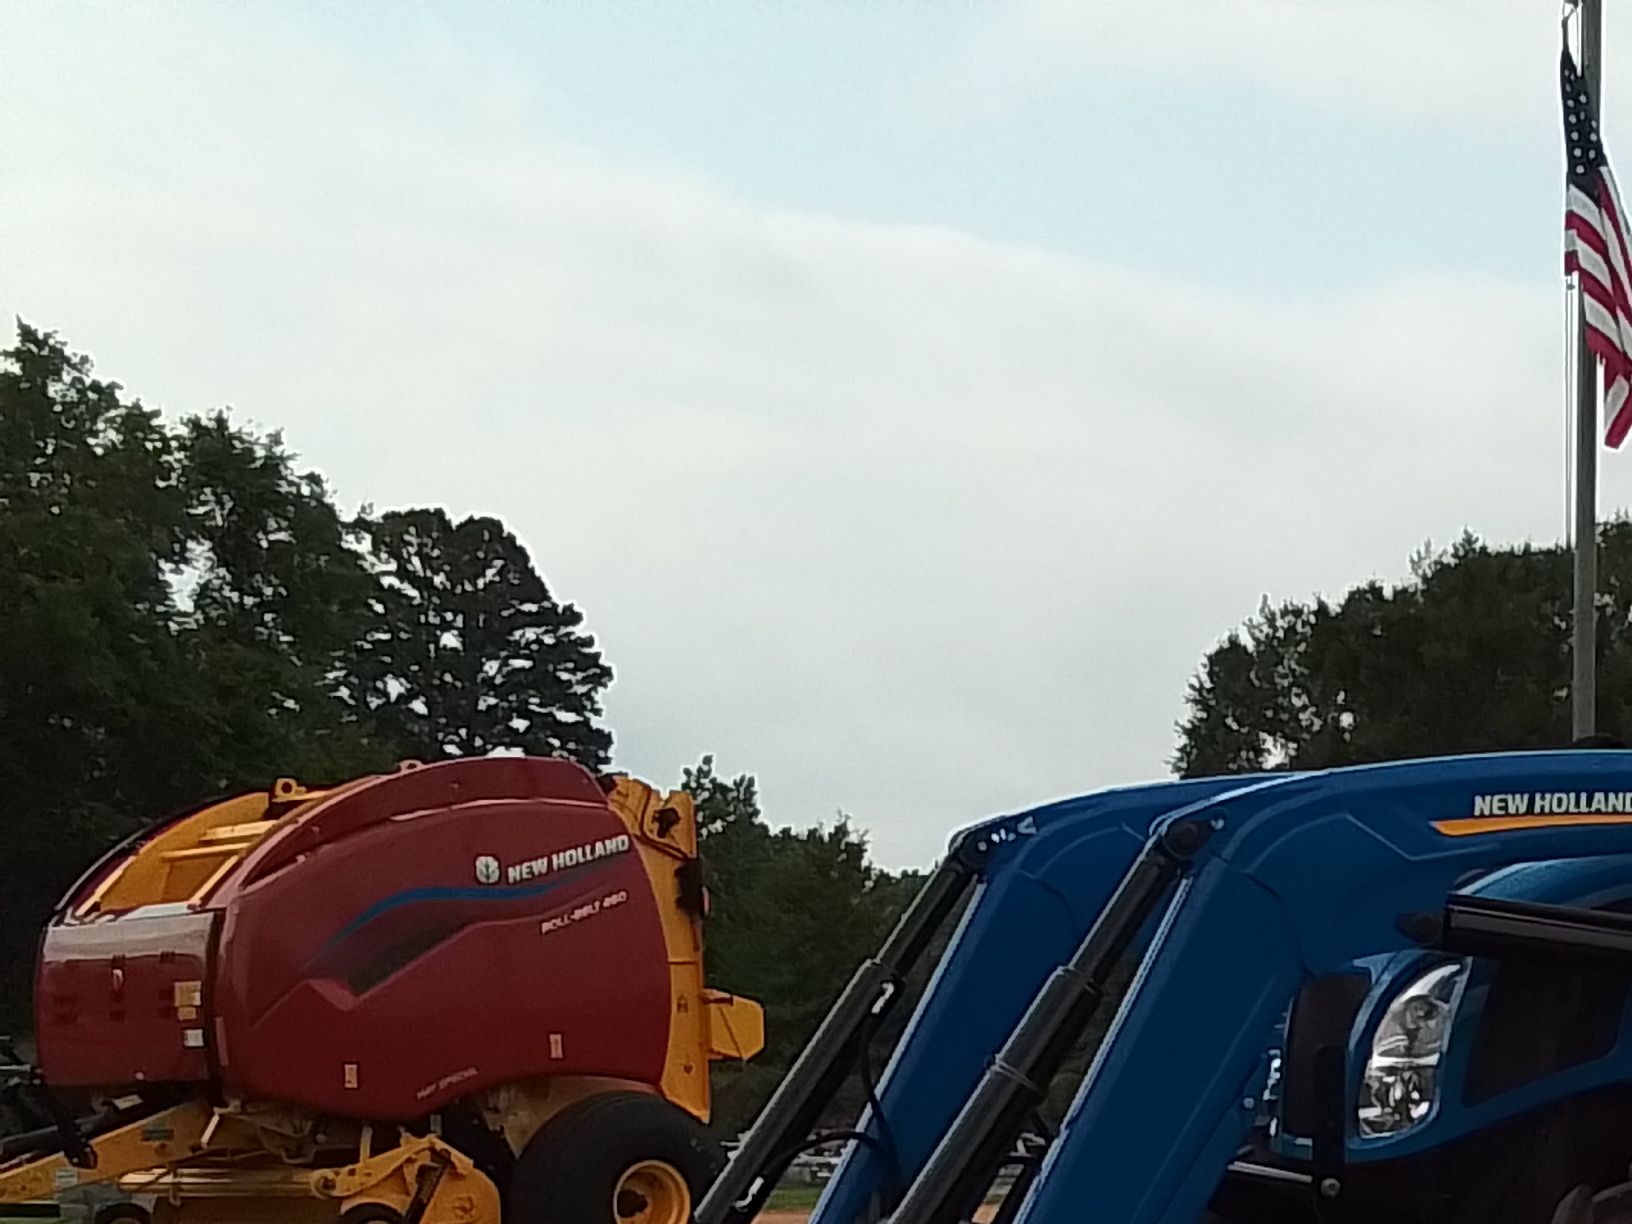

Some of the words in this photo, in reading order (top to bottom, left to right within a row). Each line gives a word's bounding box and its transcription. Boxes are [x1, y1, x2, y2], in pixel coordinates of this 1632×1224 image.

[1474, 793, 1530, 816] NEW
[508, 857, 548, 884] NEW
[552, 835, 629, 871] HOLLAND
